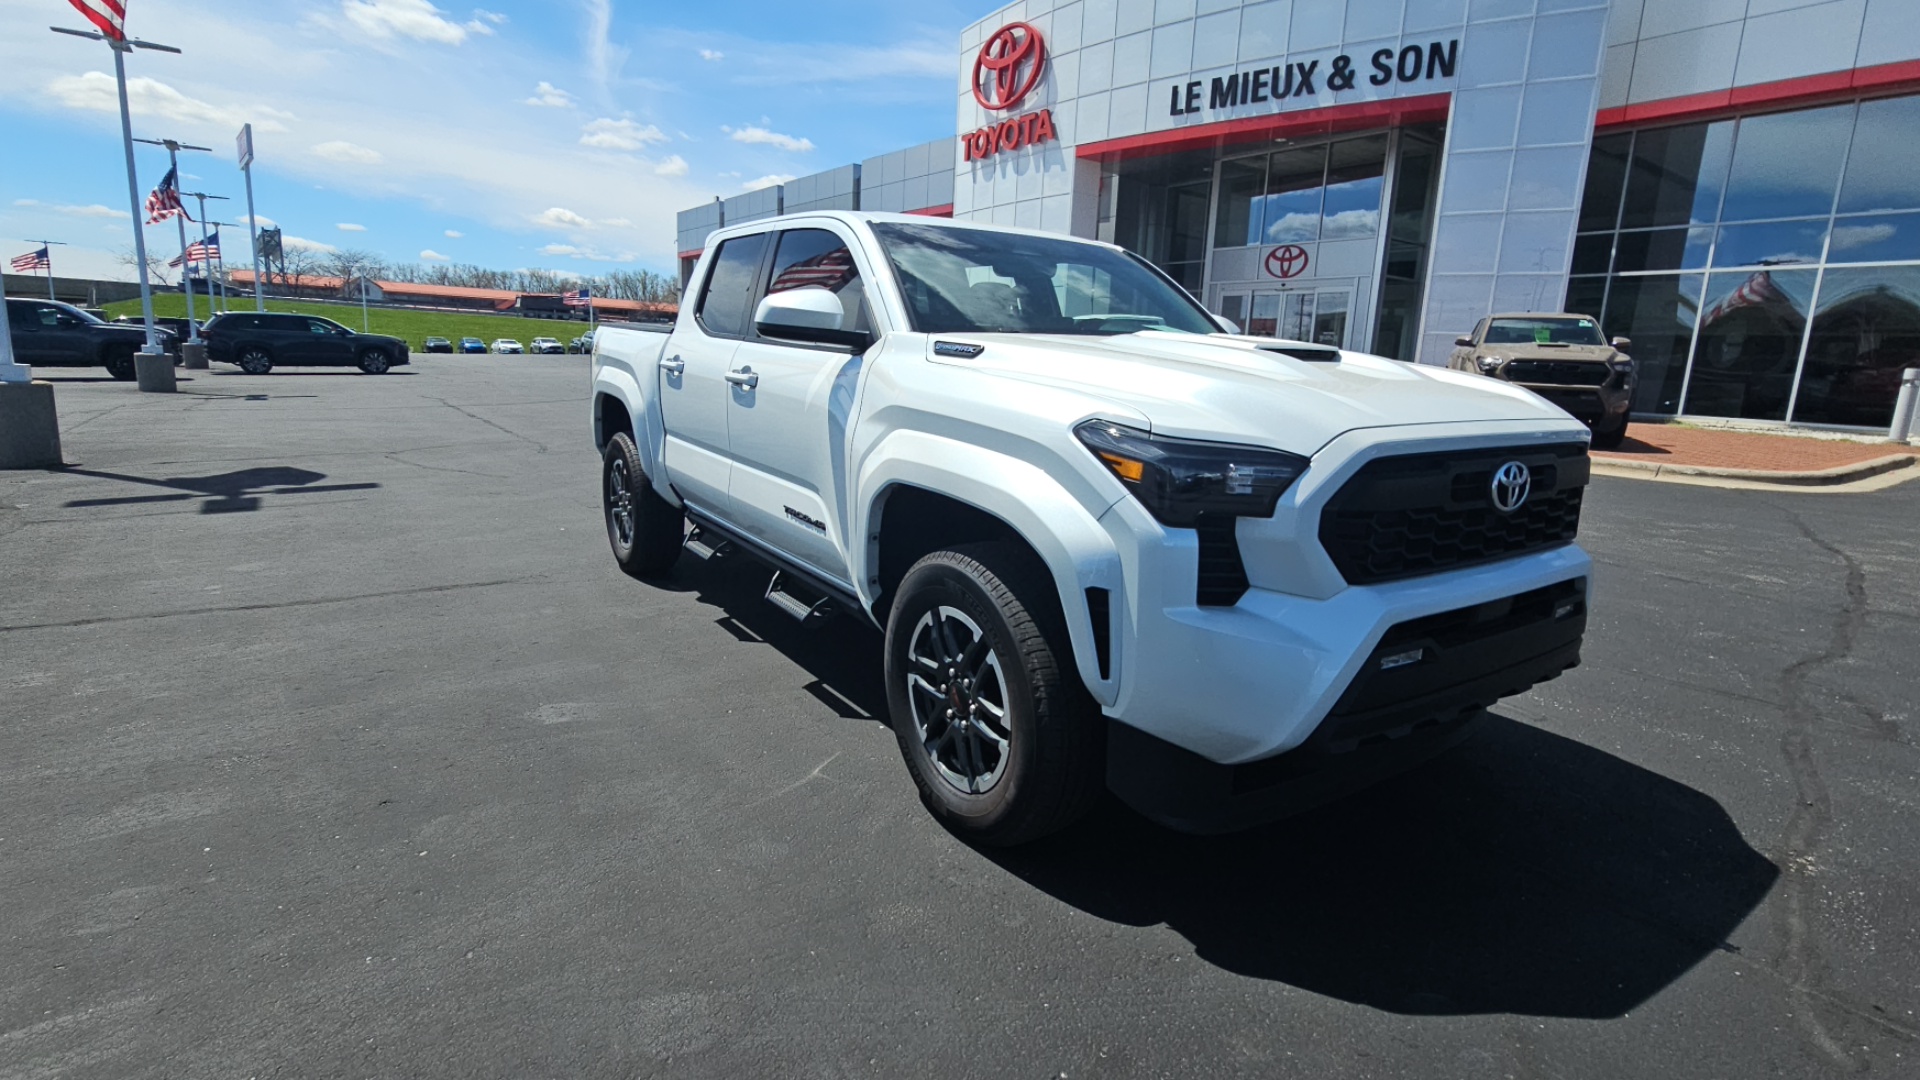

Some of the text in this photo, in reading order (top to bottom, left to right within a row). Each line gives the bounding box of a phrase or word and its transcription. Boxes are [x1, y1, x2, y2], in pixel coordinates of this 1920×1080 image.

[1170, 39, 1458, 116] LE MIEUX & SON
[962, 108, 1055, 162] TOYOTA
